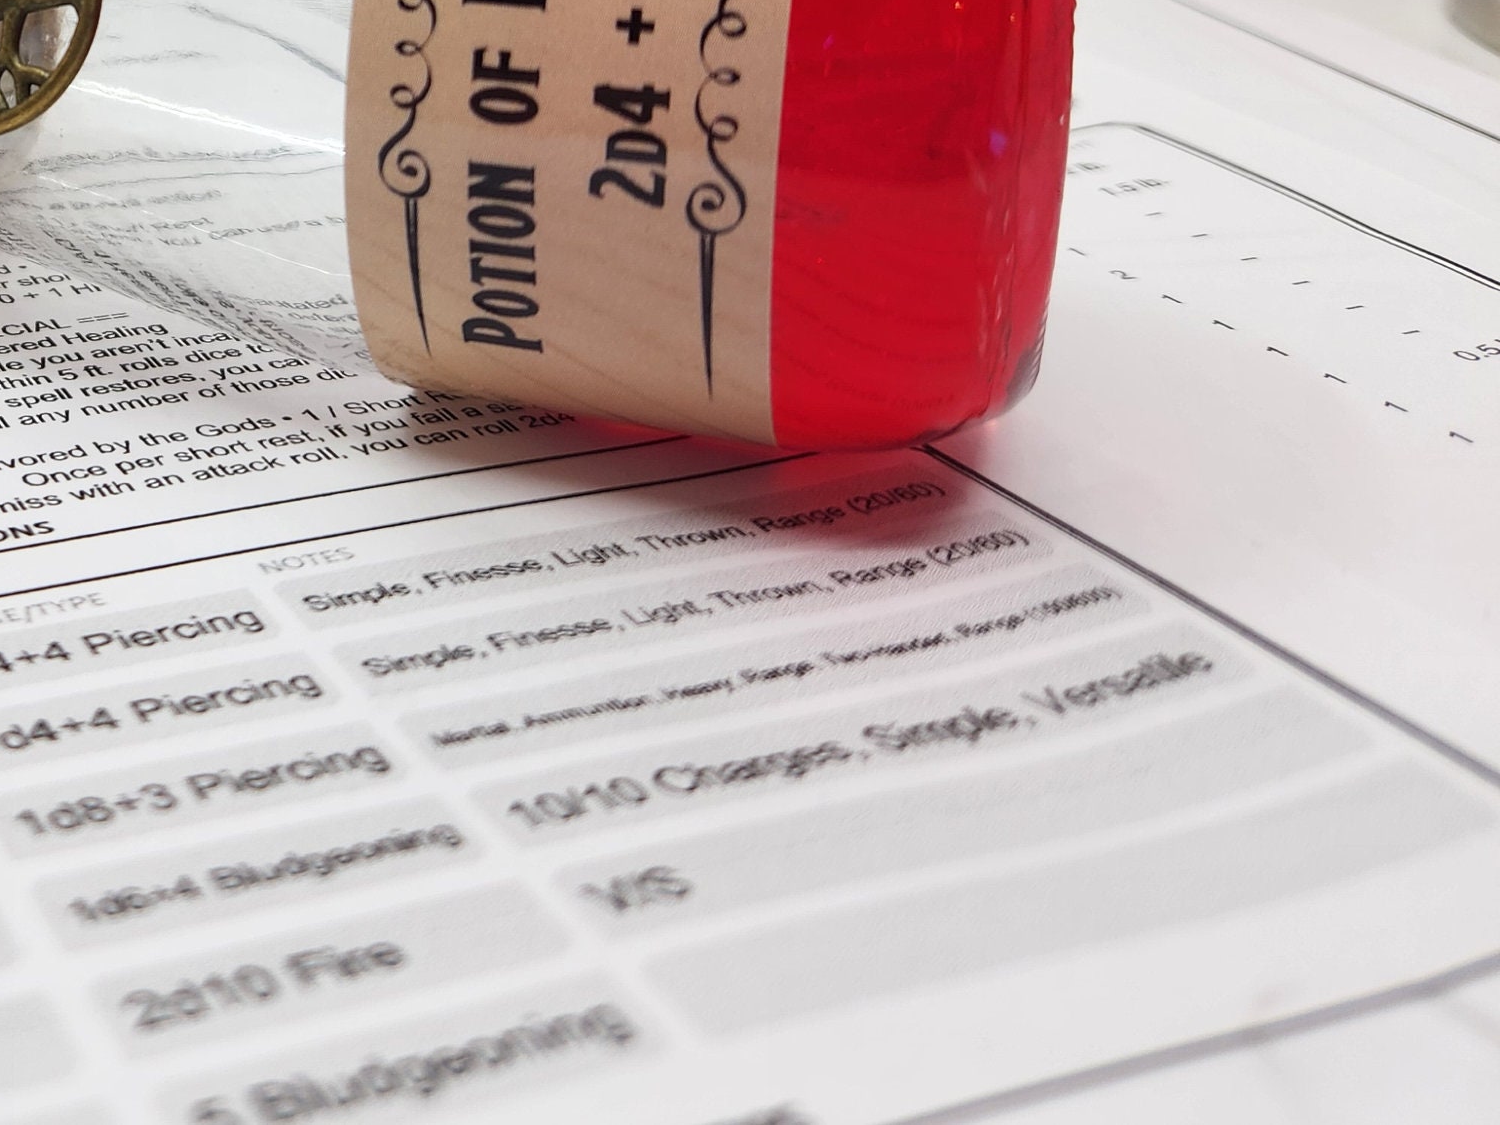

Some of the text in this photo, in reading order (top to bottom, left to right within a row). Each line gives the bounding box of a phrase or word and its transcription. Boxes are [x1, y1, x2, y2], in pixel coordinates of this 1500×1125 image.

[615, 8, 656, 46] +
[468, 46, 541, 126] OF
[461, 161, 545, 355] POTION
[29, 352, 85, 370] you
[90, 338, 171, 360] aren't
[58, 368, 78, 381] 5
[119, 355, 179, 374] rolls
[184, 344, 242, 363] dice
[61, 323, 169, 346] Healing
[4, 387, 73, 408] spell
[80, 371, 205, 398] restores,
[211, 363, 263, 381] you
[18, 409, 71, 426] any
[80, 391, 189, 417] number
[197, 384, 225, 398] of
[230, 374, 311, 394] those
[21, 407, 458, 487] Once per short rest, you fail
[92, 438, 132, 456] by
[138, 428, 190, 447] the
[194, 415, 278, 438] Gods
[343, 393, 421, 416] Short
[69, 481, 135, 501] with
[144, 473, 185, 489] an
[194, 455, 286, 482] attack
[291, 447, 348, 467] roll,
[350, 438, 409, 457] you
[413, 428, 468, 447] can
[473, 420, 520, 437] roll
[82, 610, 266, 655] Piercing
[302, 582, 422, 612] Simple,
[423, 558, 554, 589] Finesse,
[637, 523, 756, 552] Thrown,
[750, 503, 846, 534] Range
[847, 480, 947, 515] (20/60)
[257, 546, 355, 576] NOTES
[128, 674, 324, 724] Piercing
[828, 556, 928, 588] Range
[14, 783, 178, 836] 1d8+3
[186, 746, 392, 800] Piercing
[208, 823, 465, 891] Bludgeoning
